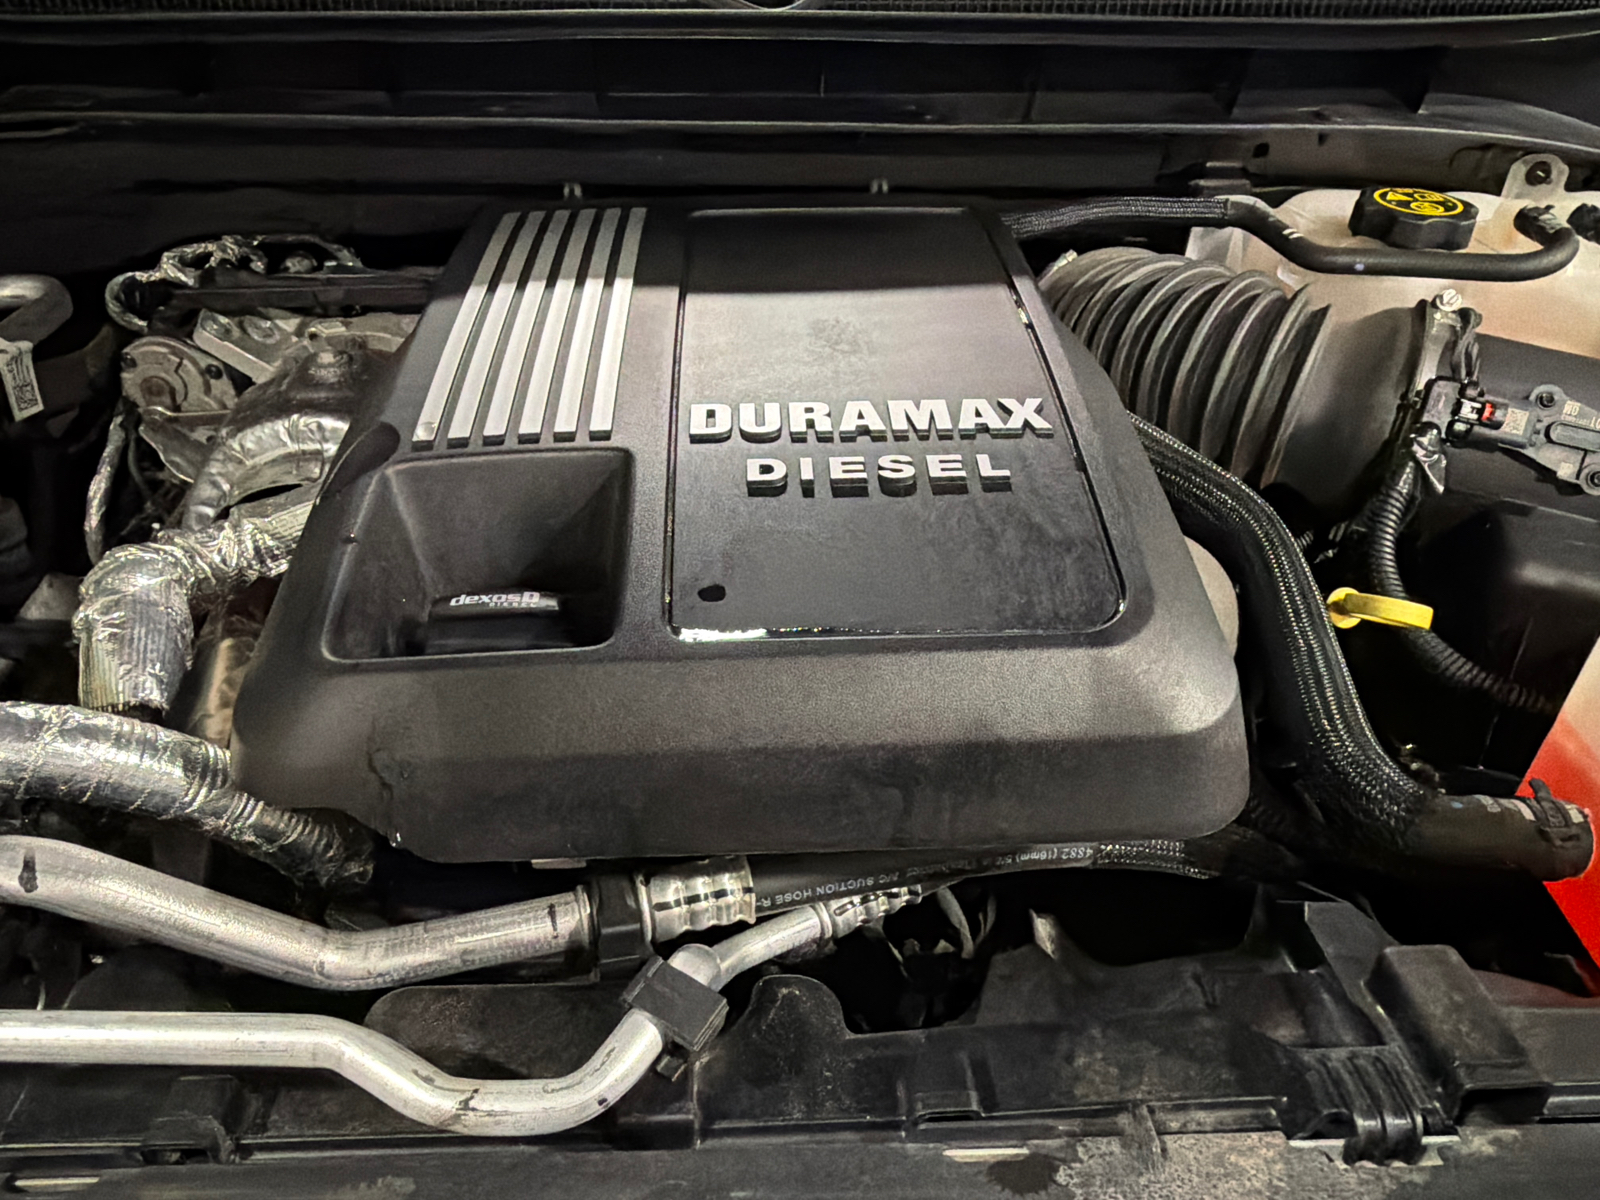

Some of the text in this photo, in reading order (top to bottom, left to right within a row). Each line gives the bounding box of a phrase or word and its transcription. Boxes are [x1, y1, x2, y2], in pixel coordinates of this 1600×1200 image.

[689, 398, 1054, 442] DURAMAX
[746, 454, 1012, 494] DIESEL
[775, 887, 812, 901] HOSE
[816, 878, 874, 896] SUCTION
